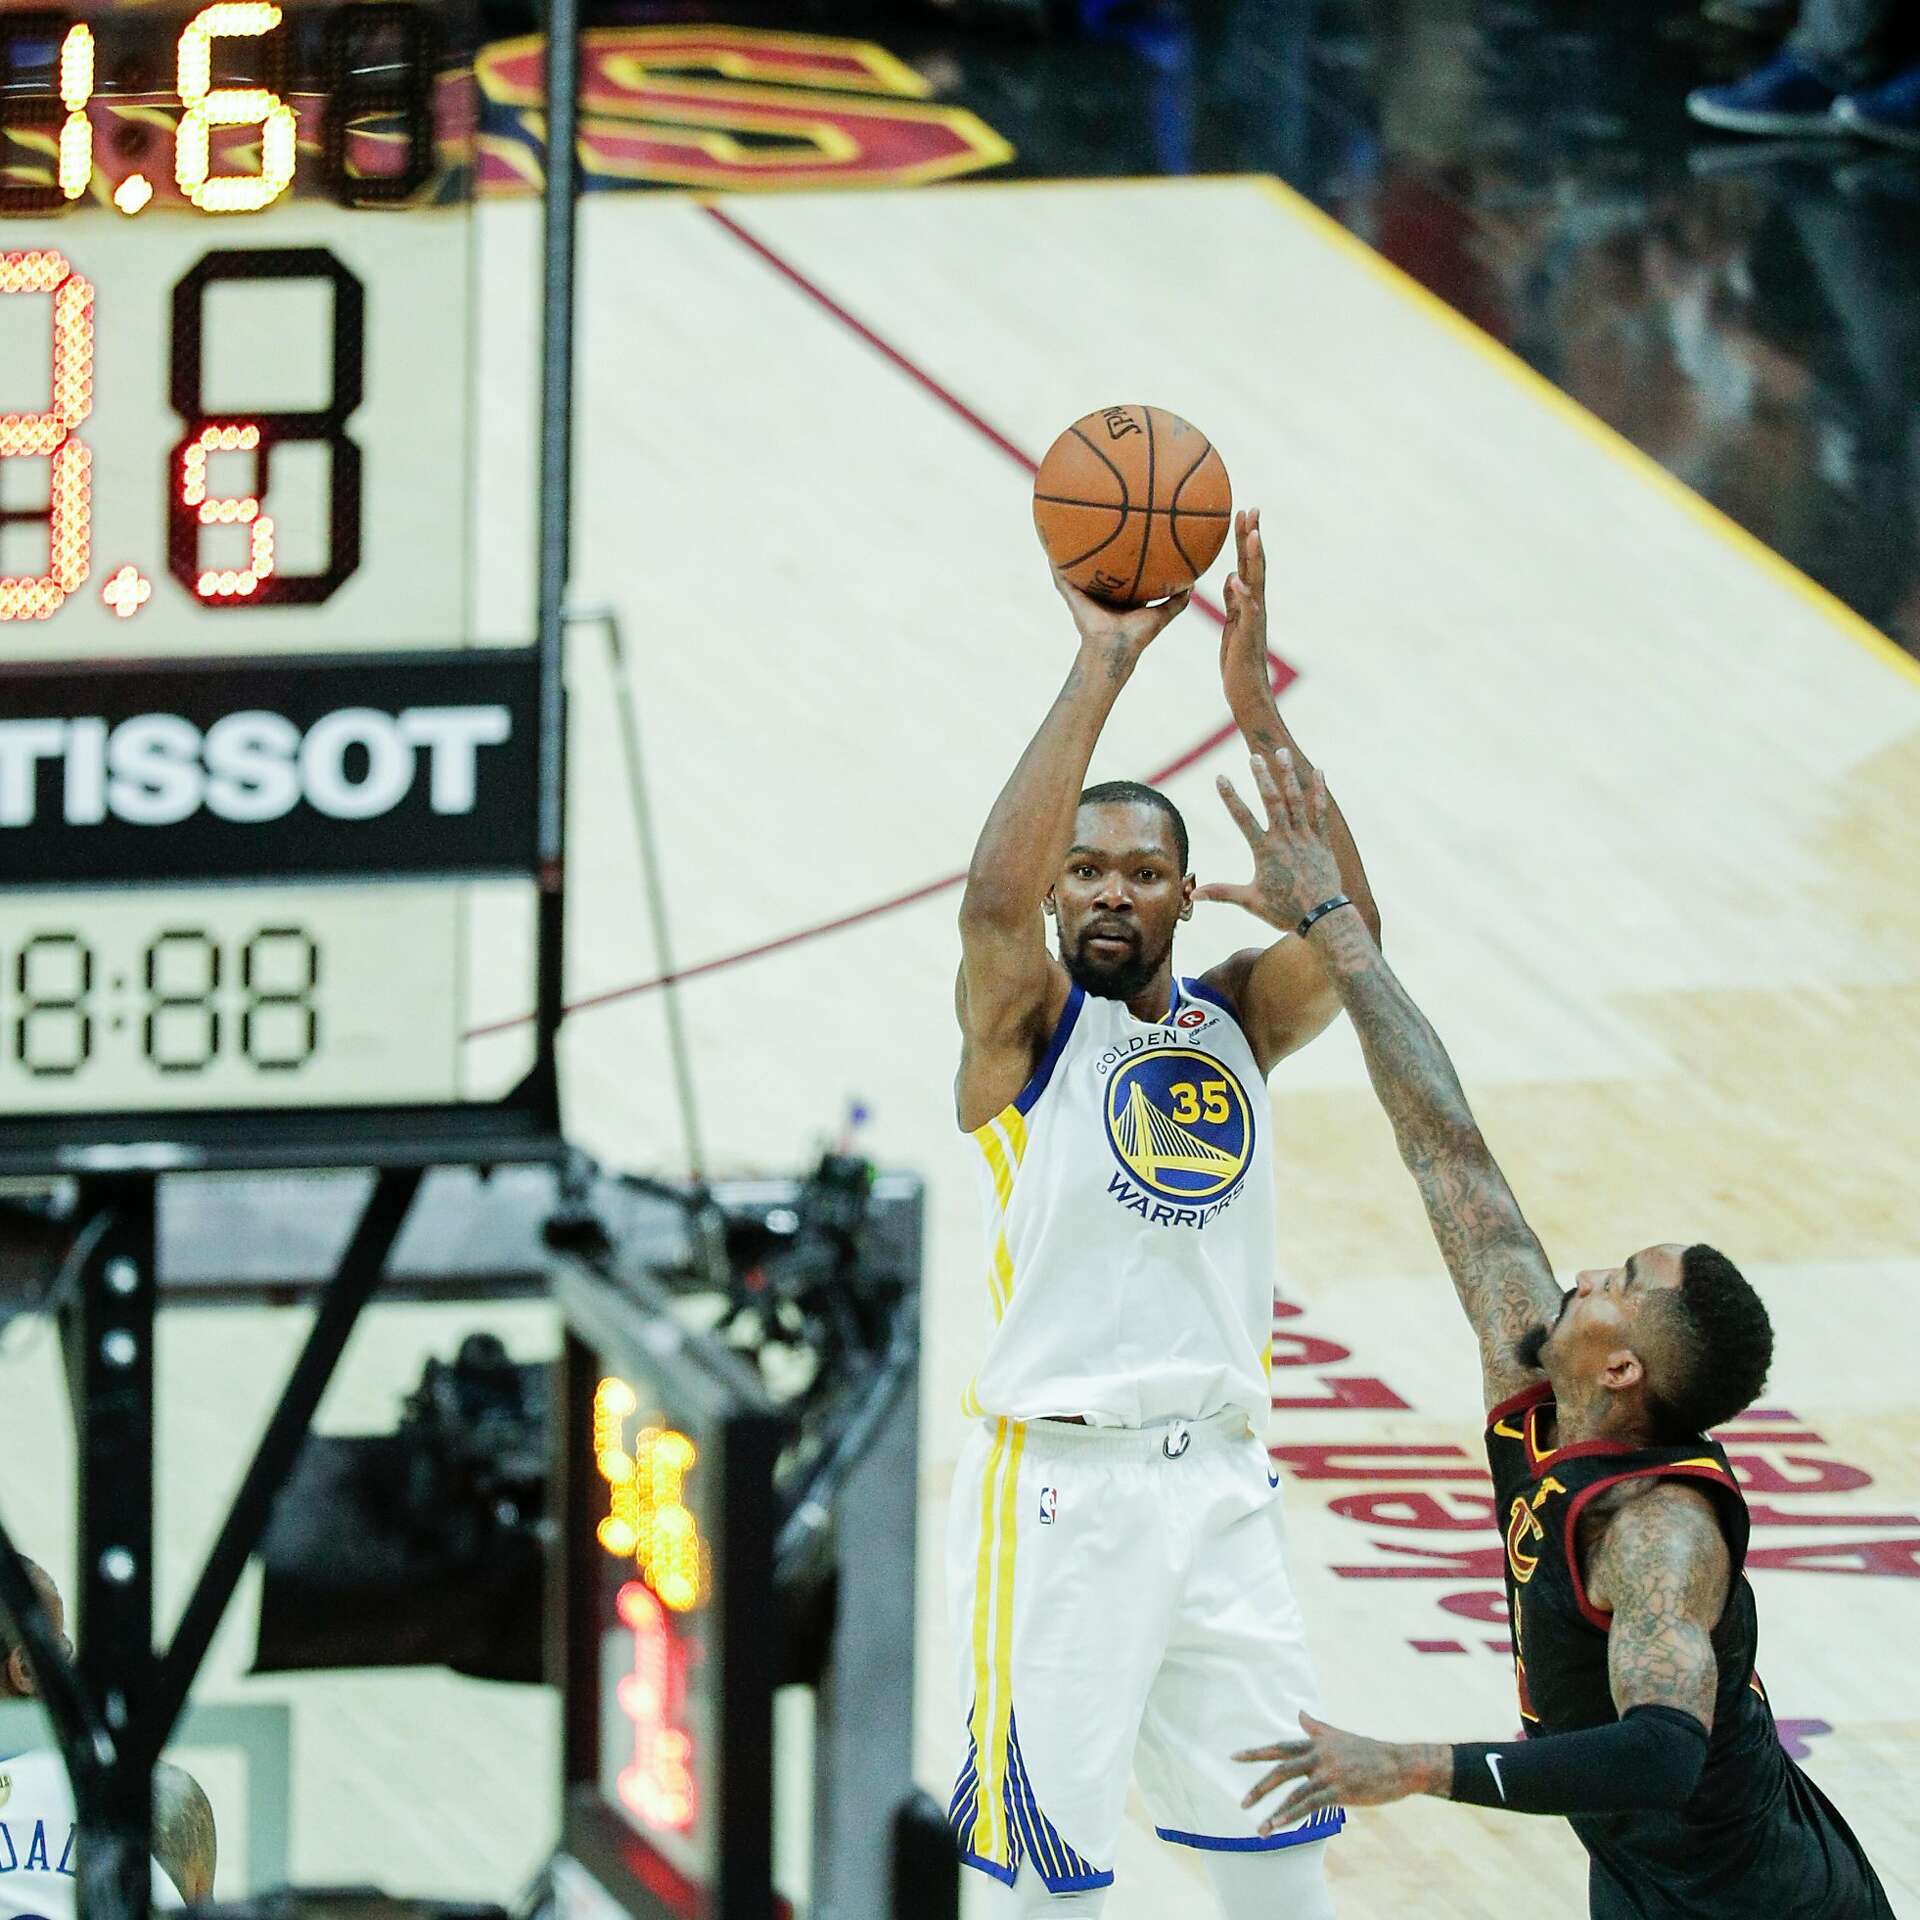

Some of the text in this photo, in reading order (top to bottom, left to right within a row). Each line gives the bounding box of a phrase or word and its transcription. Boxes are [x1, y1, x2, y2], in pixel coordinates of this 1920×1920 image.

[0, 705, 511, 827] TISSOT
[1096, 1030, 1177, 1075] GOLDEN
[1168, 1079, 1230, 1124] 35
[1107, 1170, 1245, 1229] WARRIORS
